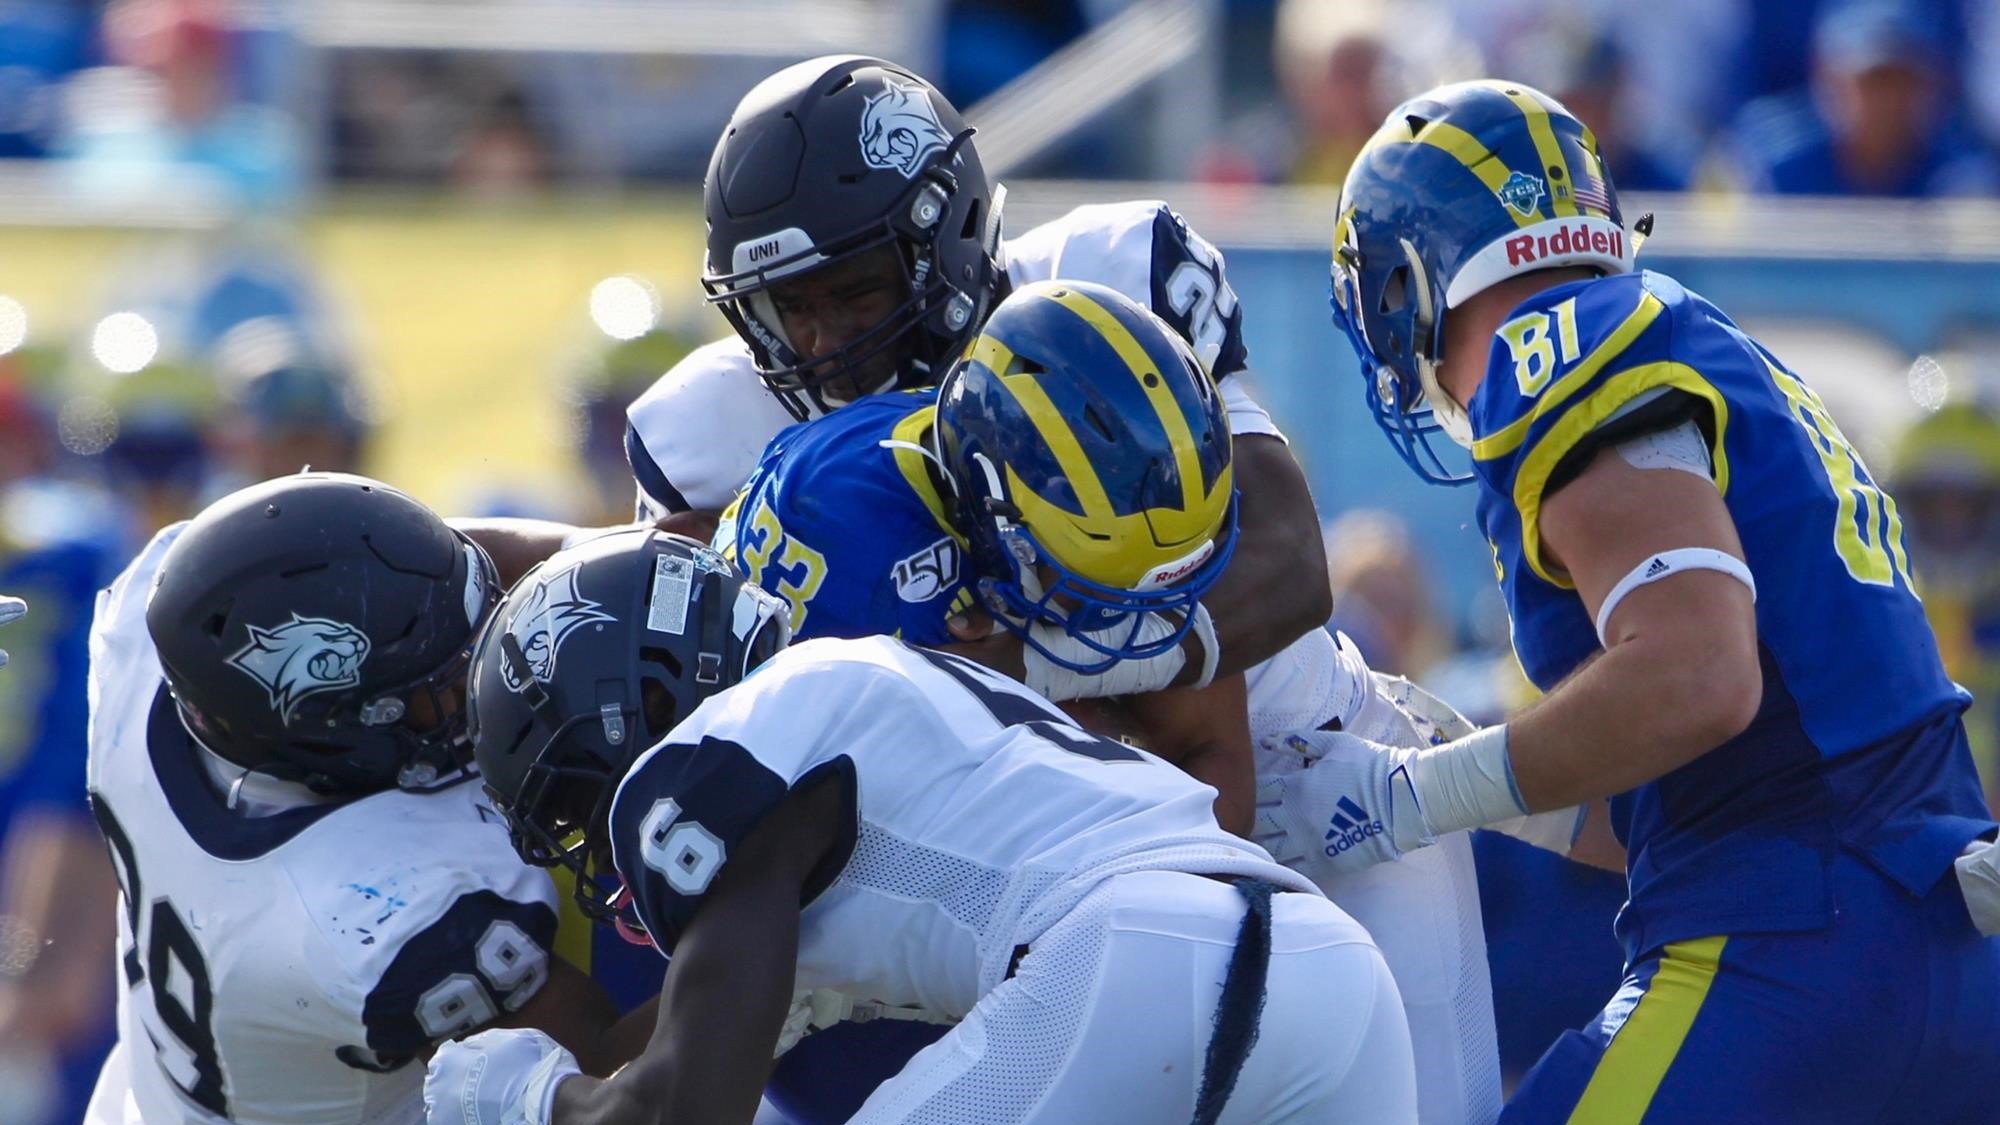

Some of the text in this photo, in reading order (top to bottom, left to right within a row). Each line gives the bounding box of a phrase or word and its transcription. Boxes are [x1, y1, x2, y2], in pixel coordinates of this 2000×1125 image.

[1504, 183, 1537, 199] FCS
[749, 240, 780, 263] UNH
[1505, 224, 1624, 268] Riddell
[1495, 296, 1582, 398] 81
[741, 496, 829, 637] 33
[889, 535, 962, 601] 150
[1154, 547, 1212, 583] Riddell
[638, 797, 727, 895] 6
[1324, 819, 1383, 857] adidas
[414, 918, 550, 1046] 99
